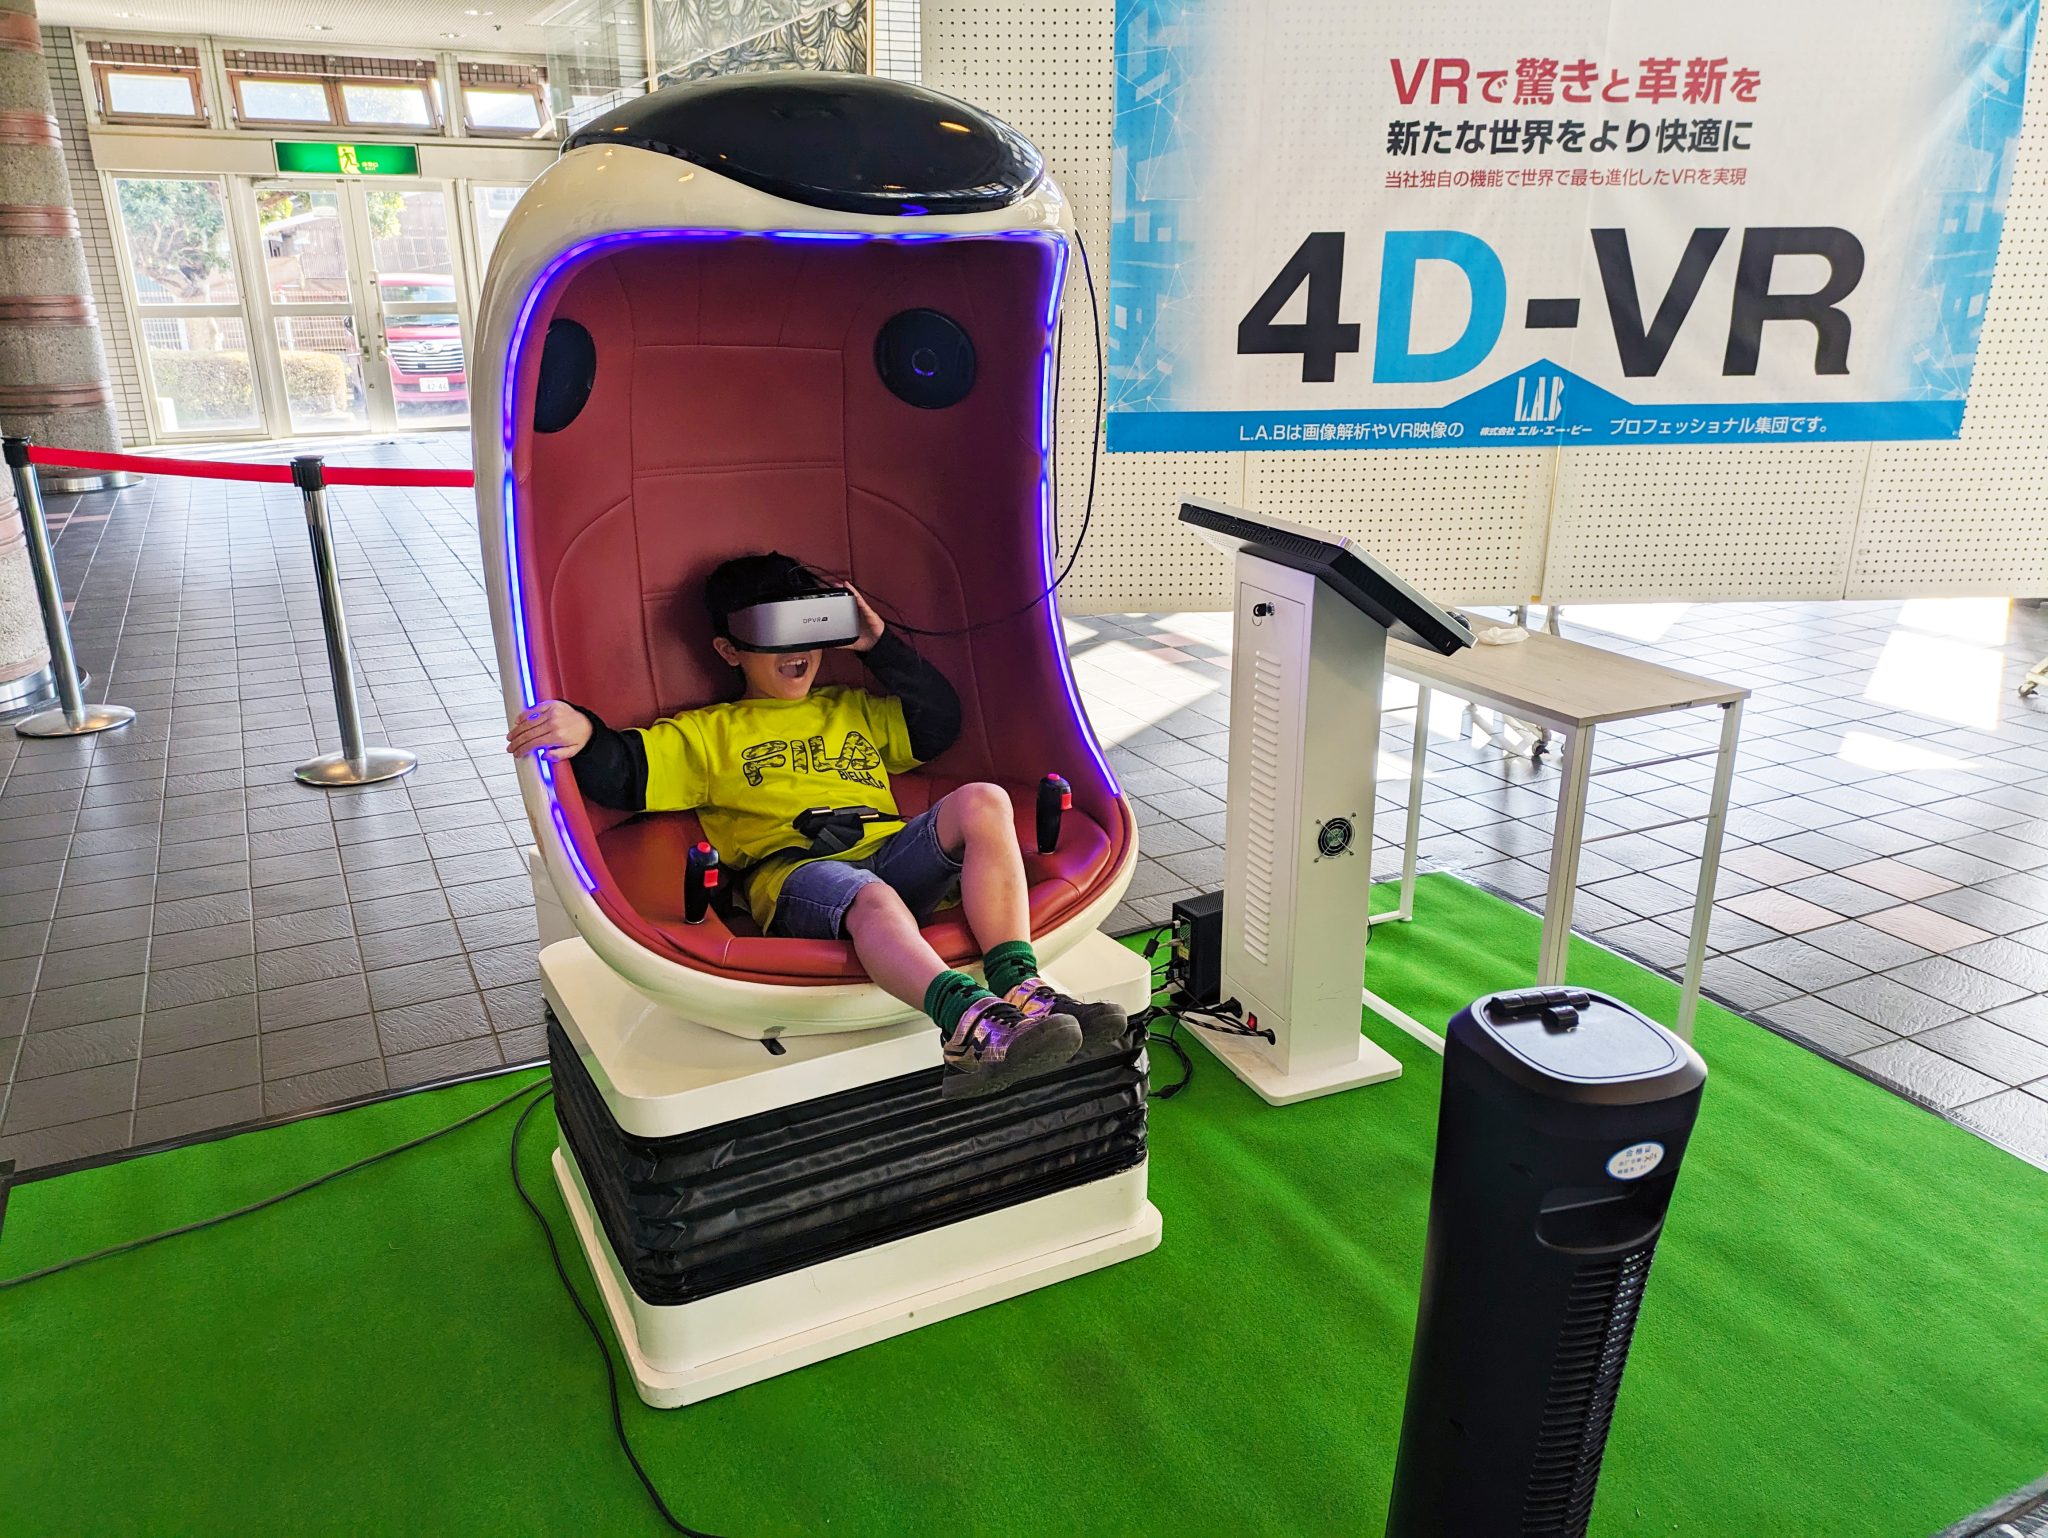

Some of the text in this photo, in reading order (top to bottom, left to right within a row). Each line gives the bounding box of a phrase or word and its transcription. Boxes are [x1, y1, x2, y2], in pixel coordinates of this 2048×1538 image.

[1390, 56, 1762, 106] VRで驚きと革新を
[1386, 118, 1753, 157] 新たな世界をより快適に
[1385, 167, 1747, 190] 当社独自の機能で世界で最も進化したVRを実現
[1237, 226, 1866, 384] 4D-VR
[1239, 421, 1464, 442] L.A.Bは画像解析やVR映像の
[1609, 416, 1829, 436] プロフェッショナル集団です。
[741, 730, 881, 787] FILA
